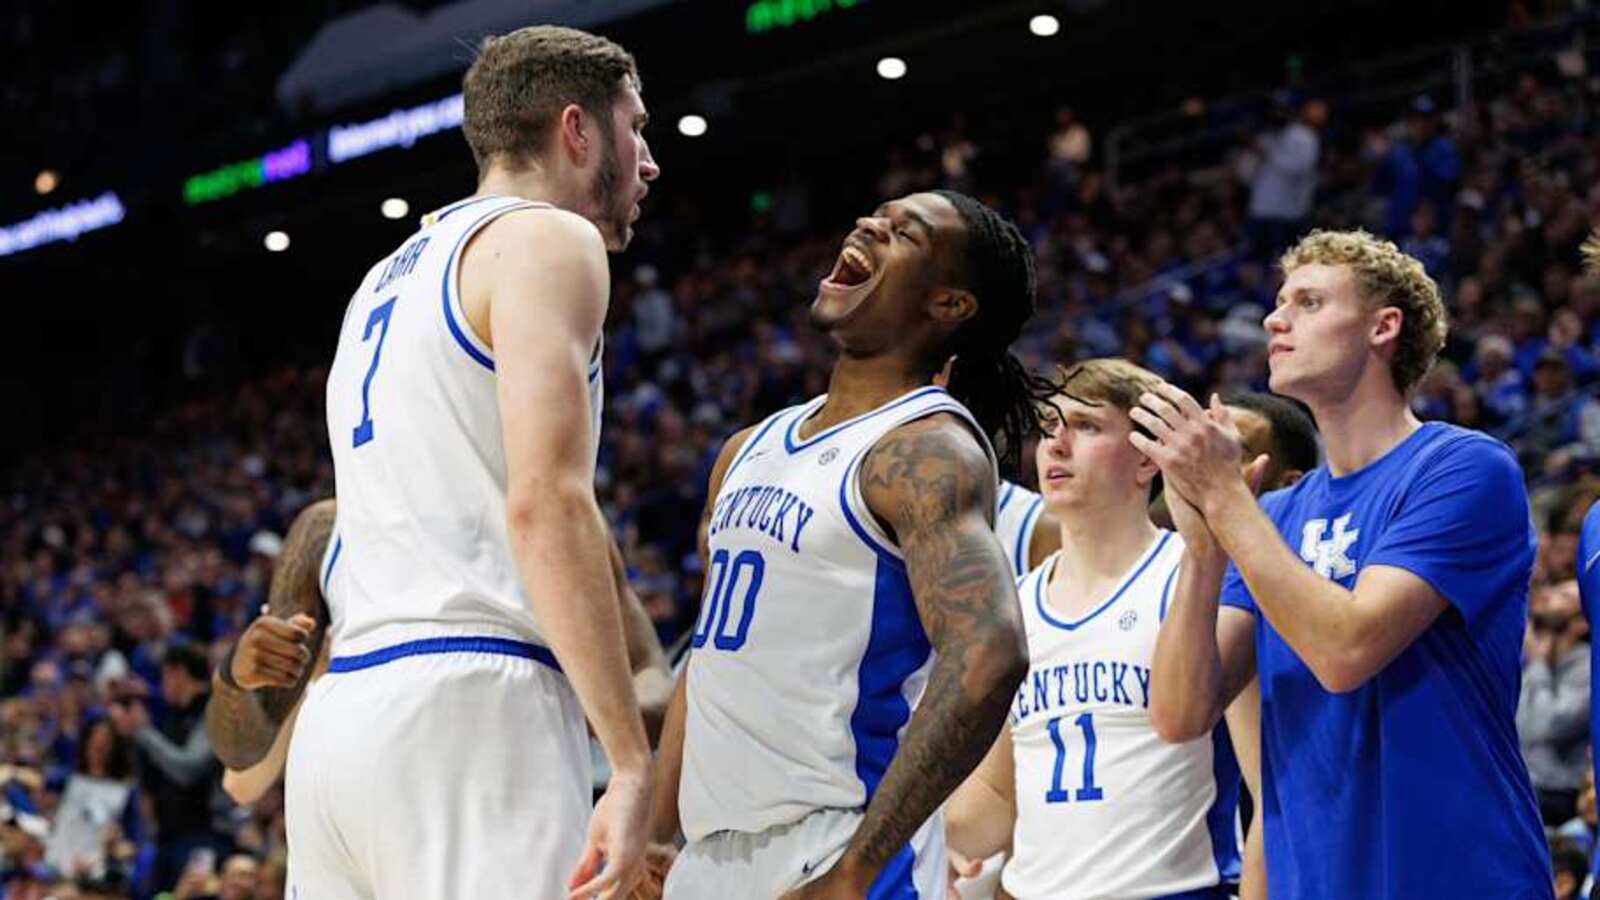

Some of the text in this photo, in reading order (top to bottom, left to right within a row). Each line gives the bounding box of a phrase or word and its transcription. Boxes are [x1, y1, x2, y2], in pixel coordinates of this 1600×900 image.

[352, 295, 398, 449] 7
[711, 486, 814, 553] ENTUCKY
[1010, 661, 1151, 727] ENTUCKY
[1046, 712, 1104, 803] 11
